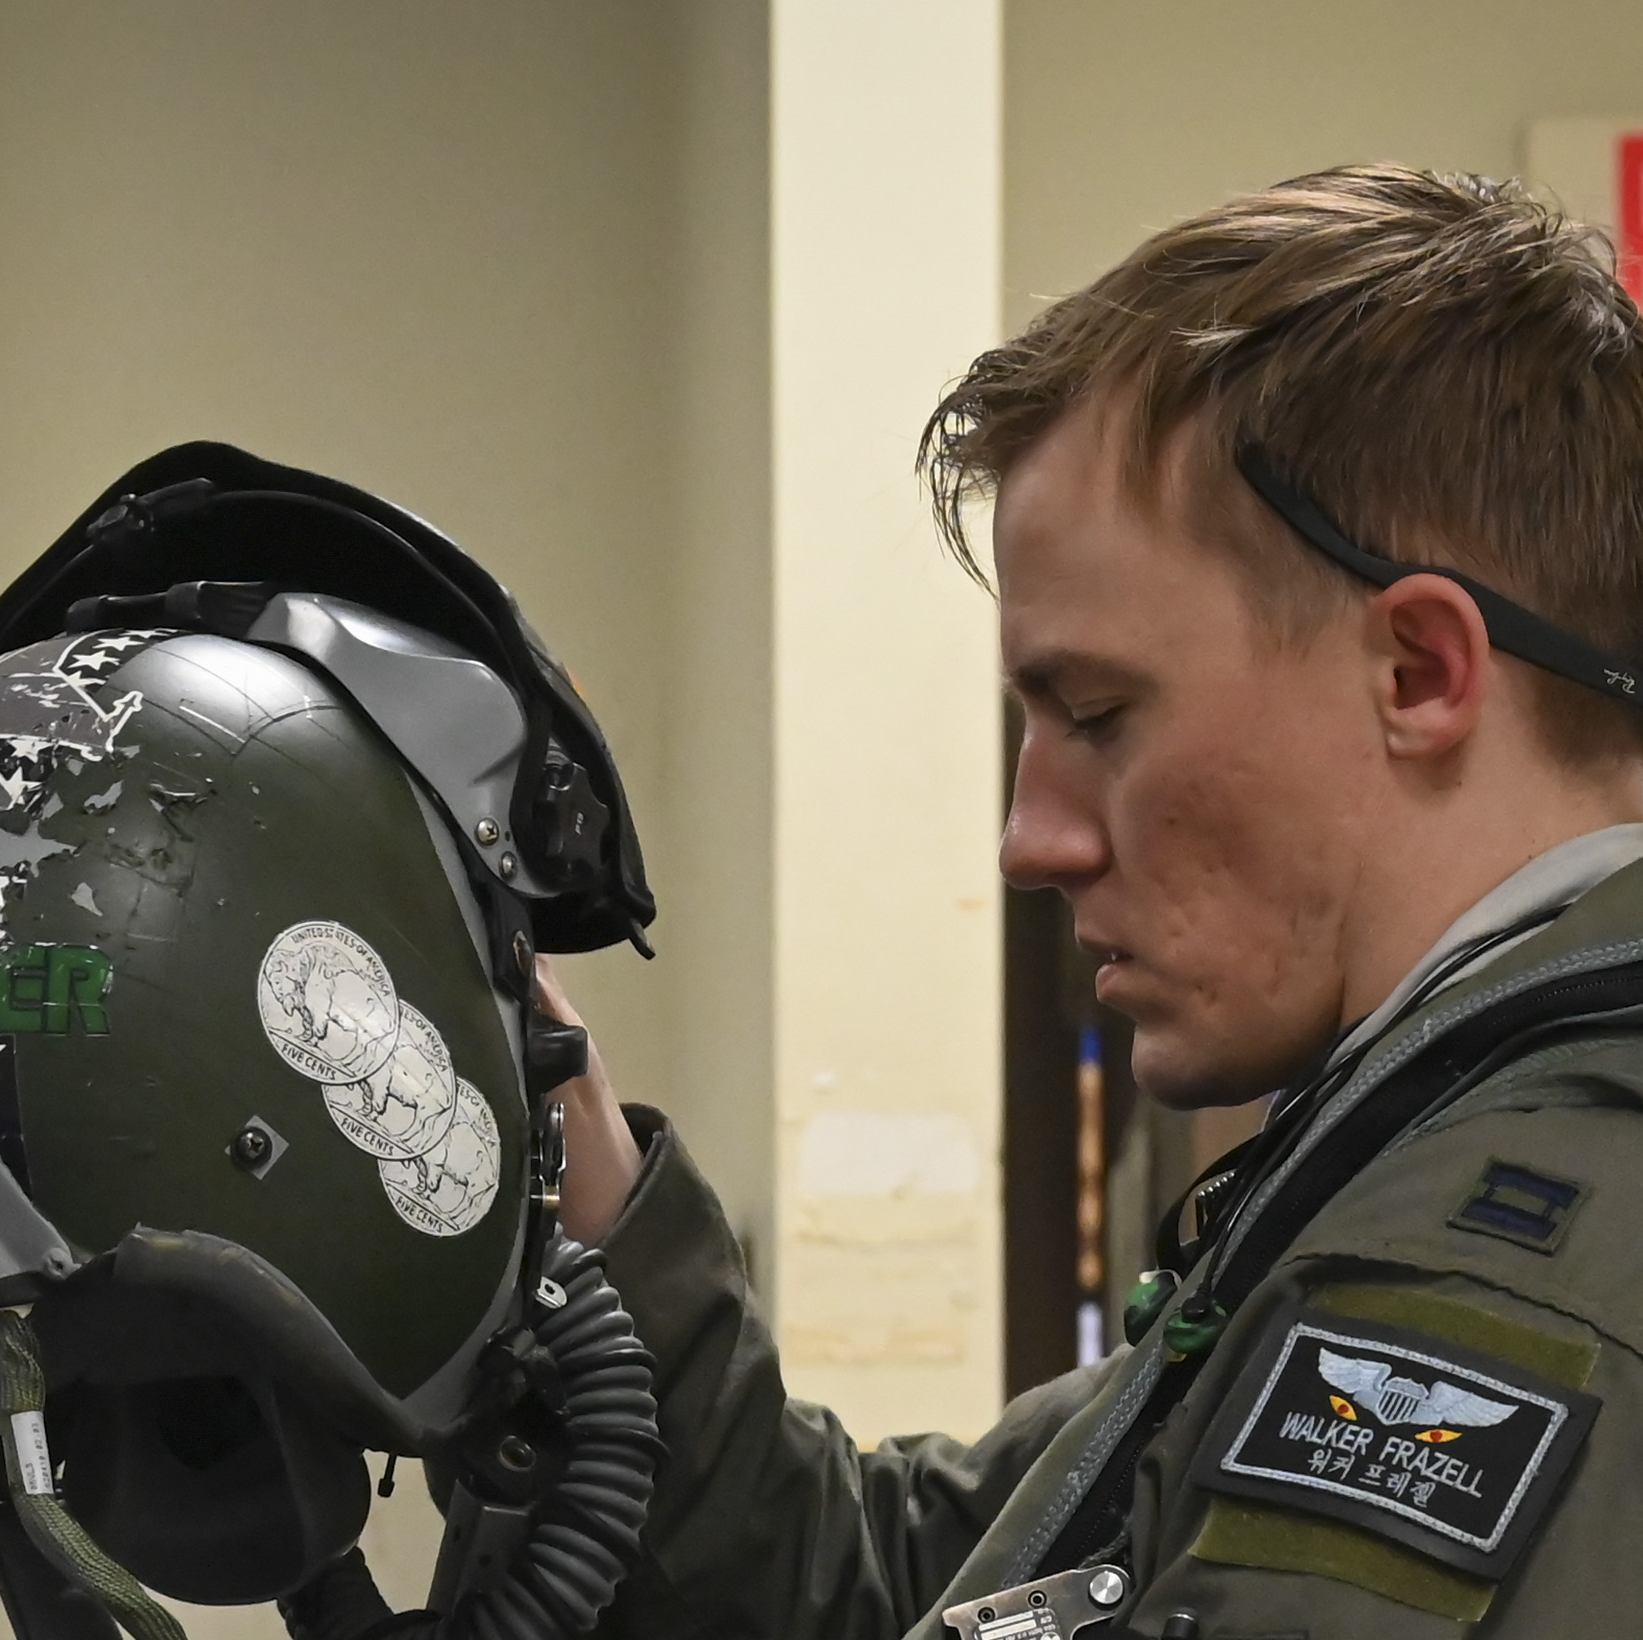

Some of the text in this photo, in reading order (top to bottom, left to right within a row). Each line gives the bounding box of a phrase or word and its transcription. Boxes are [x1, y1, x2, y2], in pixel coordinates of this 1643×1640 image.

[281, 1043, 337, 1081] FIVE CENTS
[340, 1117, 394, 1156] FIVE CENTS
[395, 1195, 444, 1233] FIVE CENTS
[1279, 1411, 1484, 1499] WALKER FRAZELL
